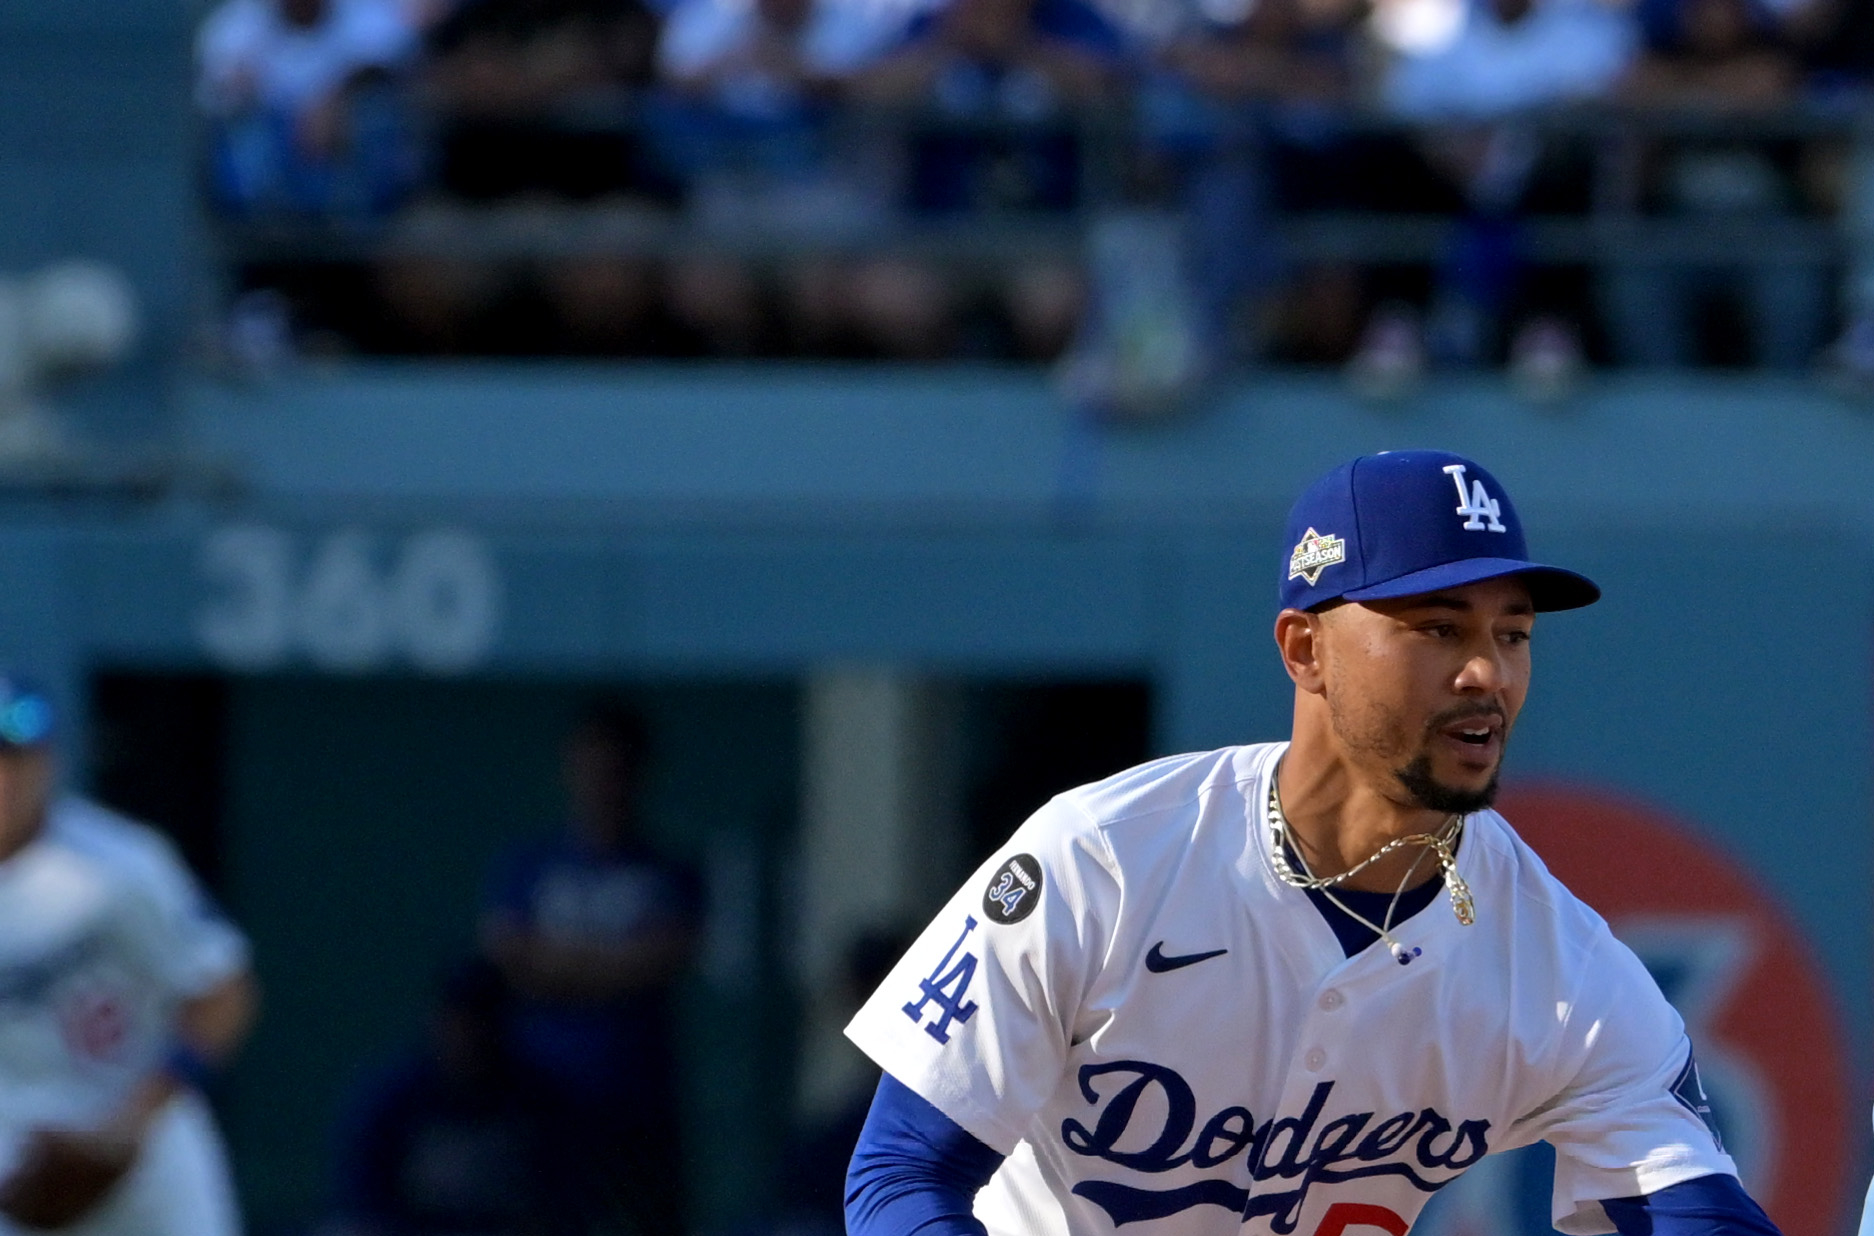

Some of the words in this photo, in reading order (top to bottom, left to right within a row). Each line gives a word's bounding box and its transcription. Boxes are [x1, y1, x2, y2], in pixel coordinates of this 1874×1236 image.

[1443, 464, 1506, 533] LA
[200, 523, 500, 676] 360
[989, 872, 1027, 917] 34
[901, 915, 978, 1045] LA
[1062, 1059, 1490, 1234] Dodgers
